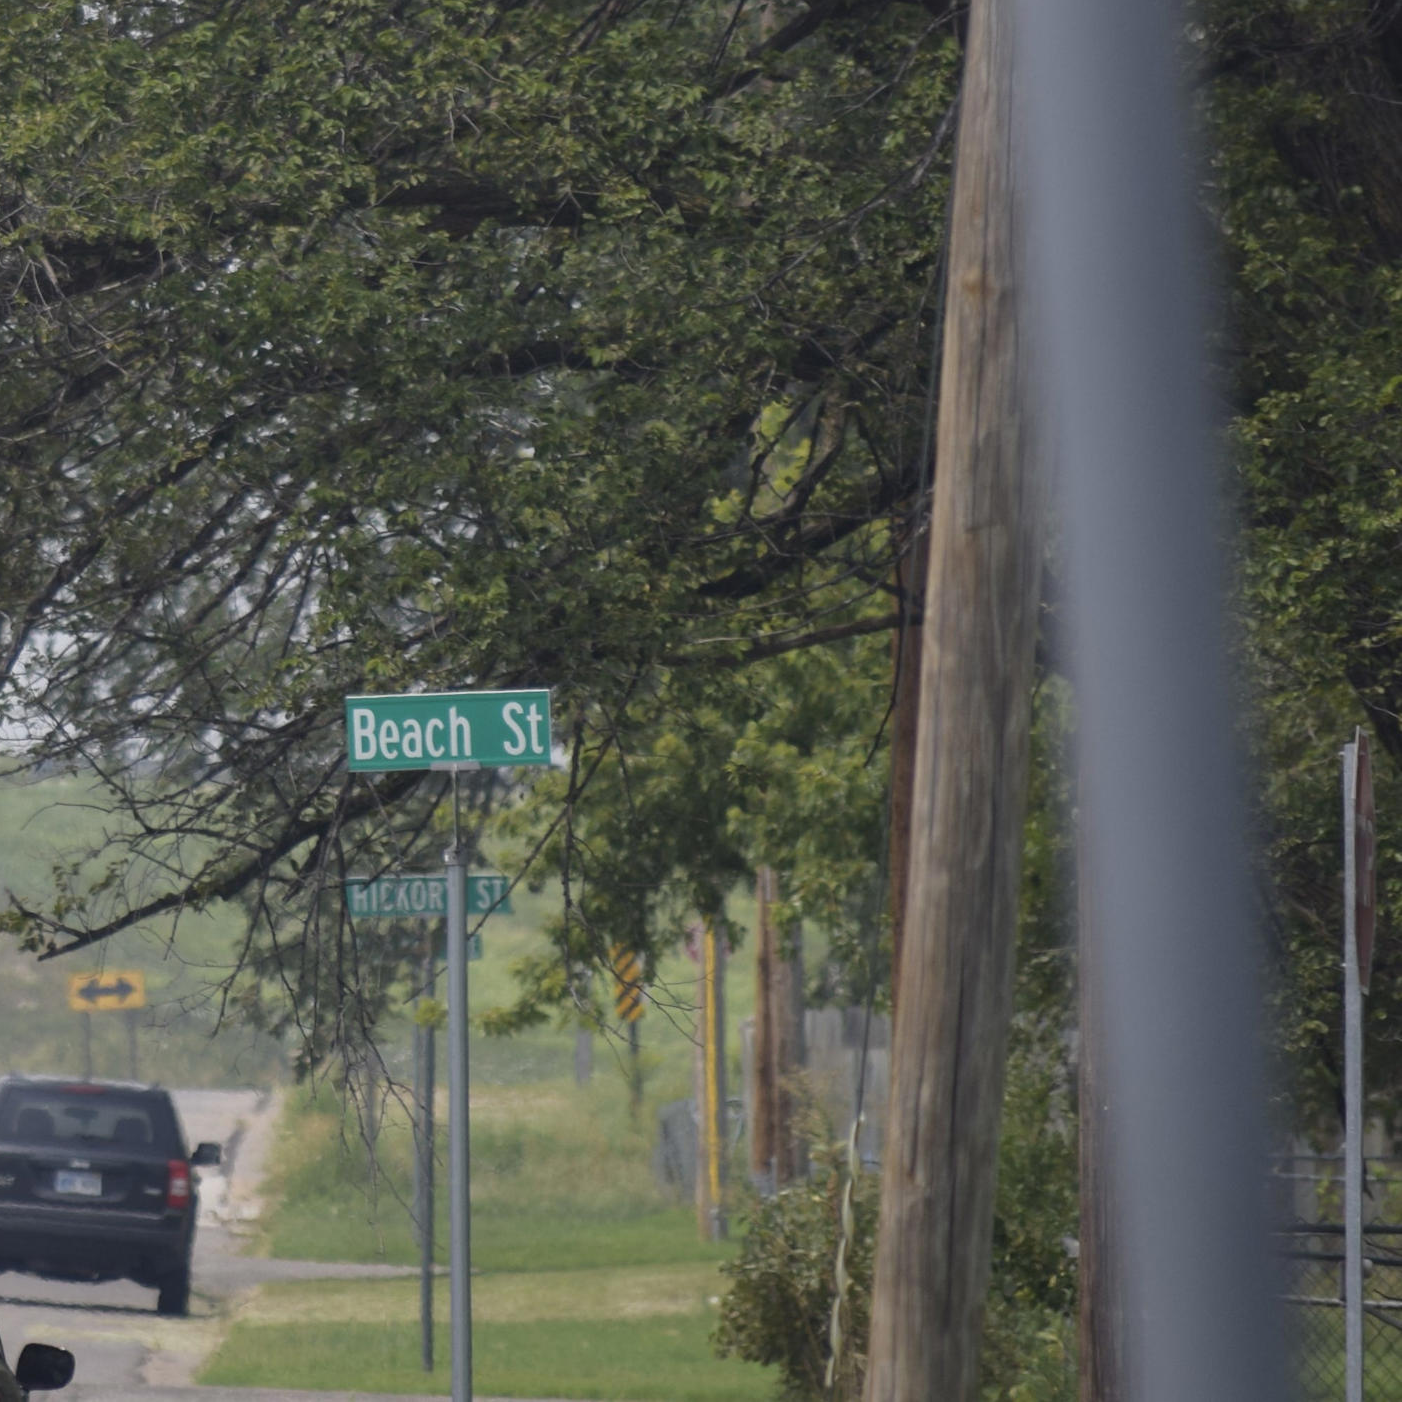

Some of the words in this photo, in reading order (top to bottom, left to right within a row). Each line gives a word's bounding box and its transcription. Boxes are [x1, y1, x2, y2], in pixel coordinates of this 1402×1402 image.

[352, 705, 472, 760] Beach
[502, 701, 544, 755] St
[352, 880, 448, 912] HICKOR
[476, 878, 505, 910] ST
